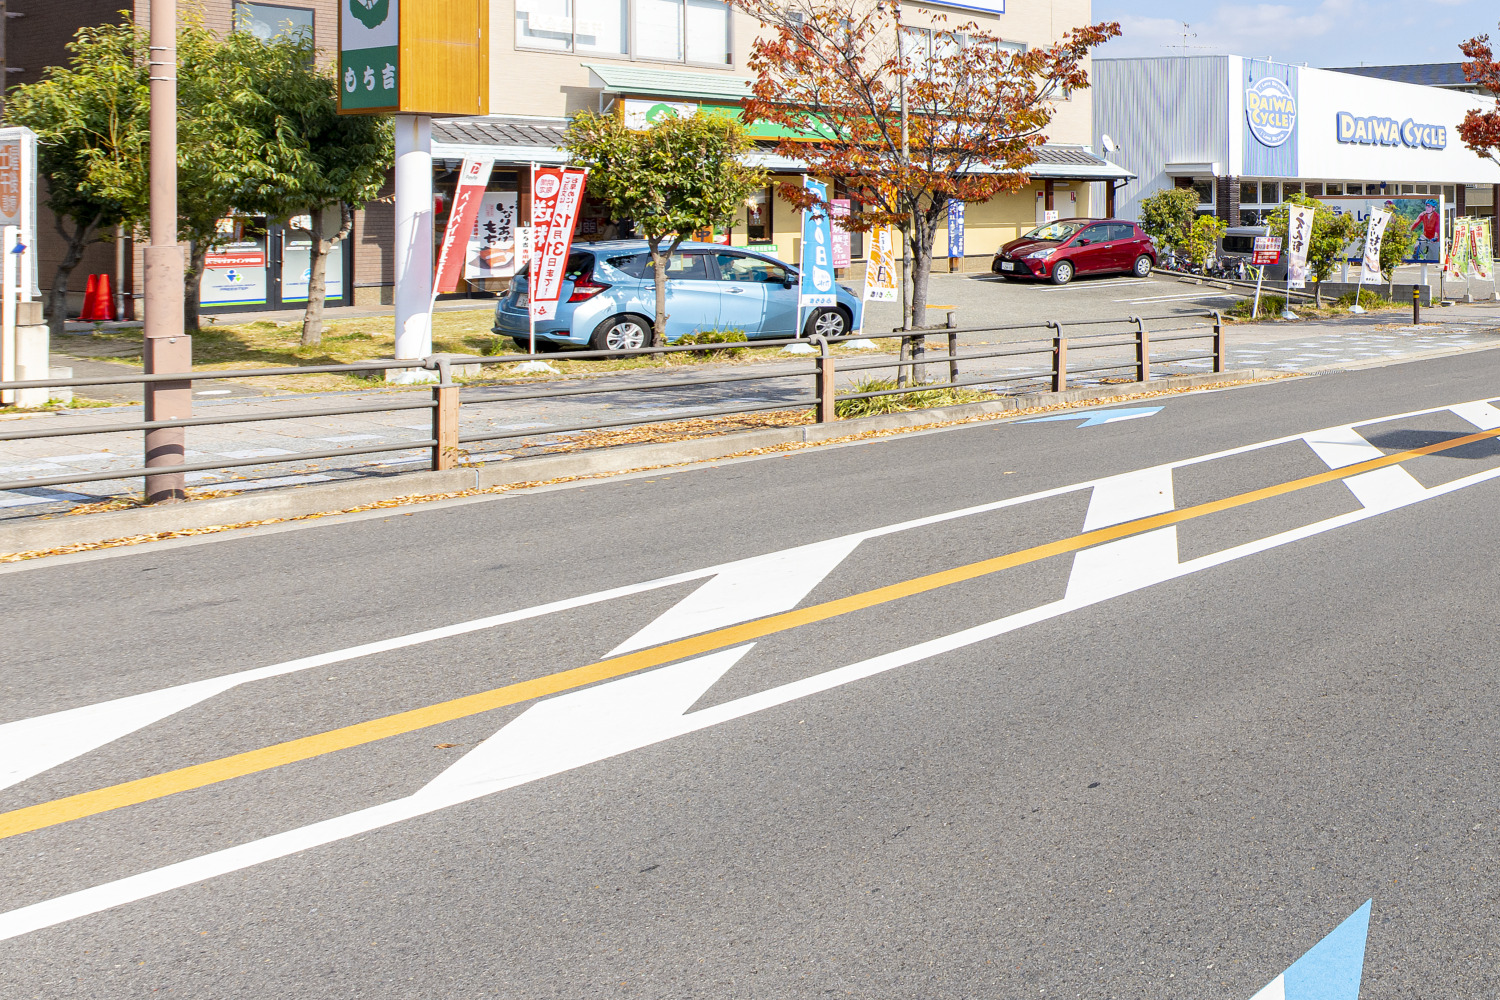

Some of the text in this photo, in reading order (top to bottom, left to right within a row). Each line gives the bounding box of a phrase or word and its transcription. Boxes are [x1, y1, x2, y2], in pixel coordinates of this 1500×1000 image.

[344, 62, 396, 93] もち吉
[1249, 92, 1294, 114] DAIWA
[1252, 108, 1289, 127] CYCLE
[1338, 112, 1446, 147] DAIWA CYCLE
